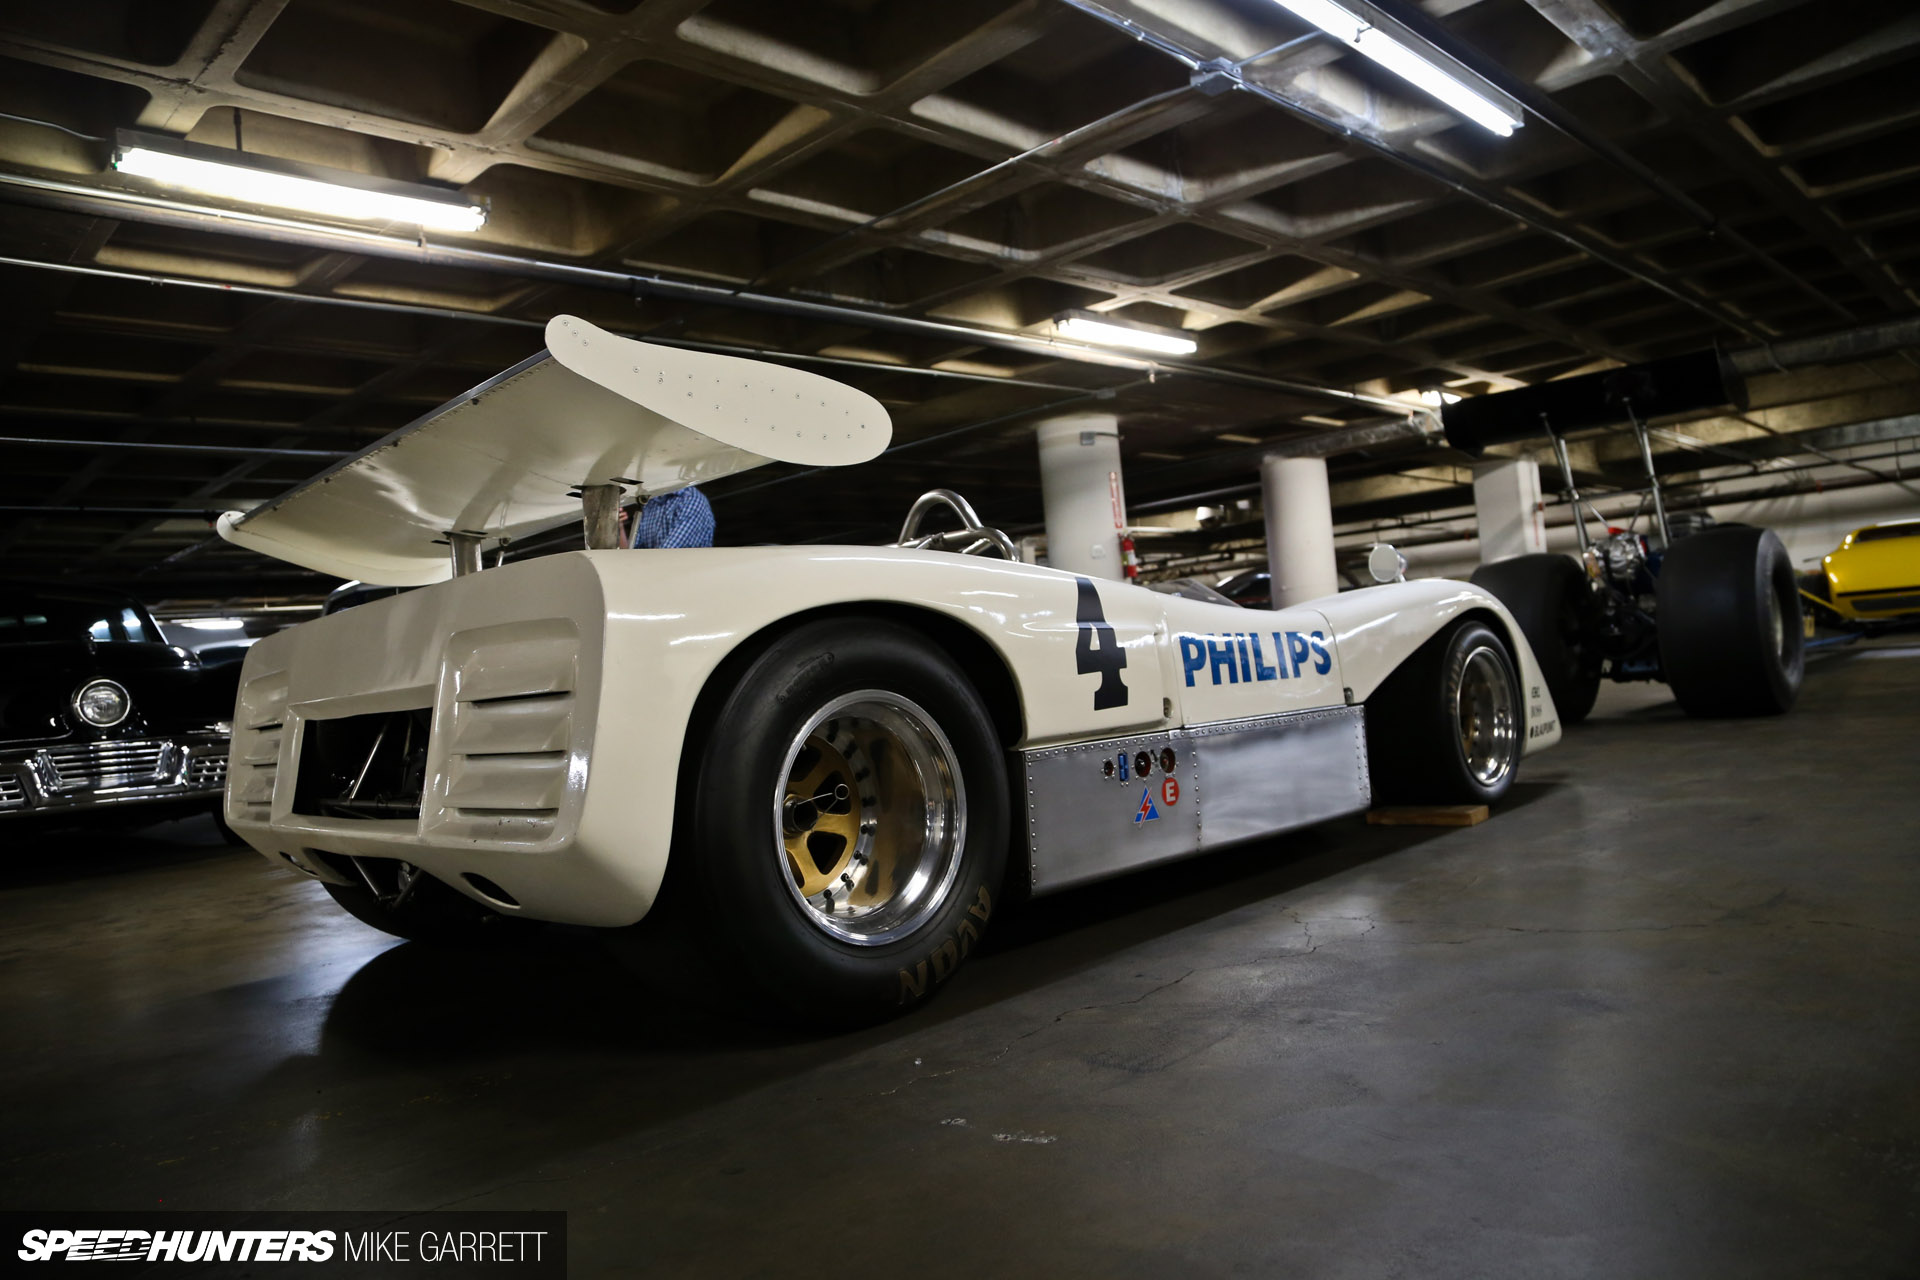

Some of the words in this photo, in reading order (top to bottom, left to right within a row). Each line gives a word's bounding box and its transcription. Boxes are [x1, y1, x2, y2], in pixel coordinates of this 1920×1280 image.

[1075, 577, 1128, 710] 4
[1179, 630, 1332, 687] PHILIPS
[1165, 782, 1176, 802] E
[898, 885, 992, 1005] AVON
